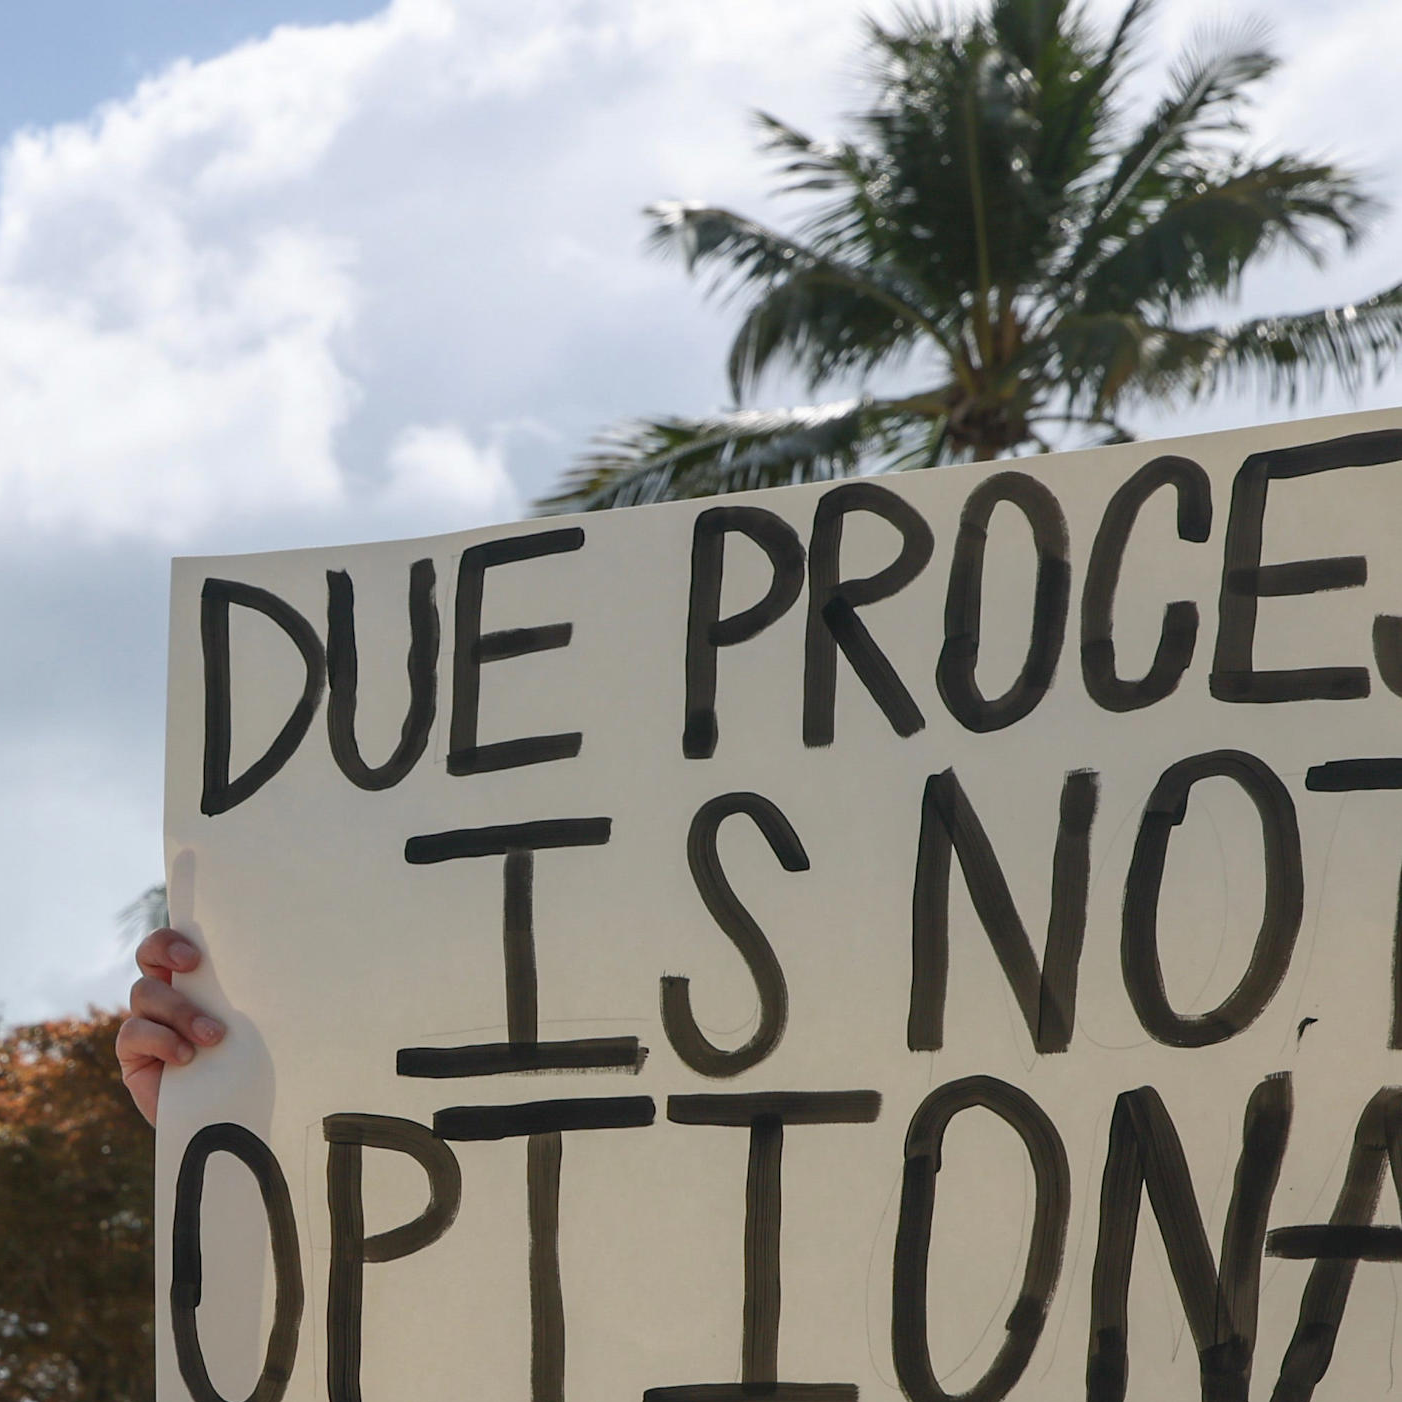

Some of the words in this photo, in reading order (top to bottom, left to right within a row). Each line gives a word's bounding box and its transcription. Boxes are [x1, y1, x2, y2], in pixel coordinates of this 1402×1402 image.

[201, 527, 585, 817] DUE
[682, 428, 1402, 758] PROCE
[396, 792, 810, 1079] IS
